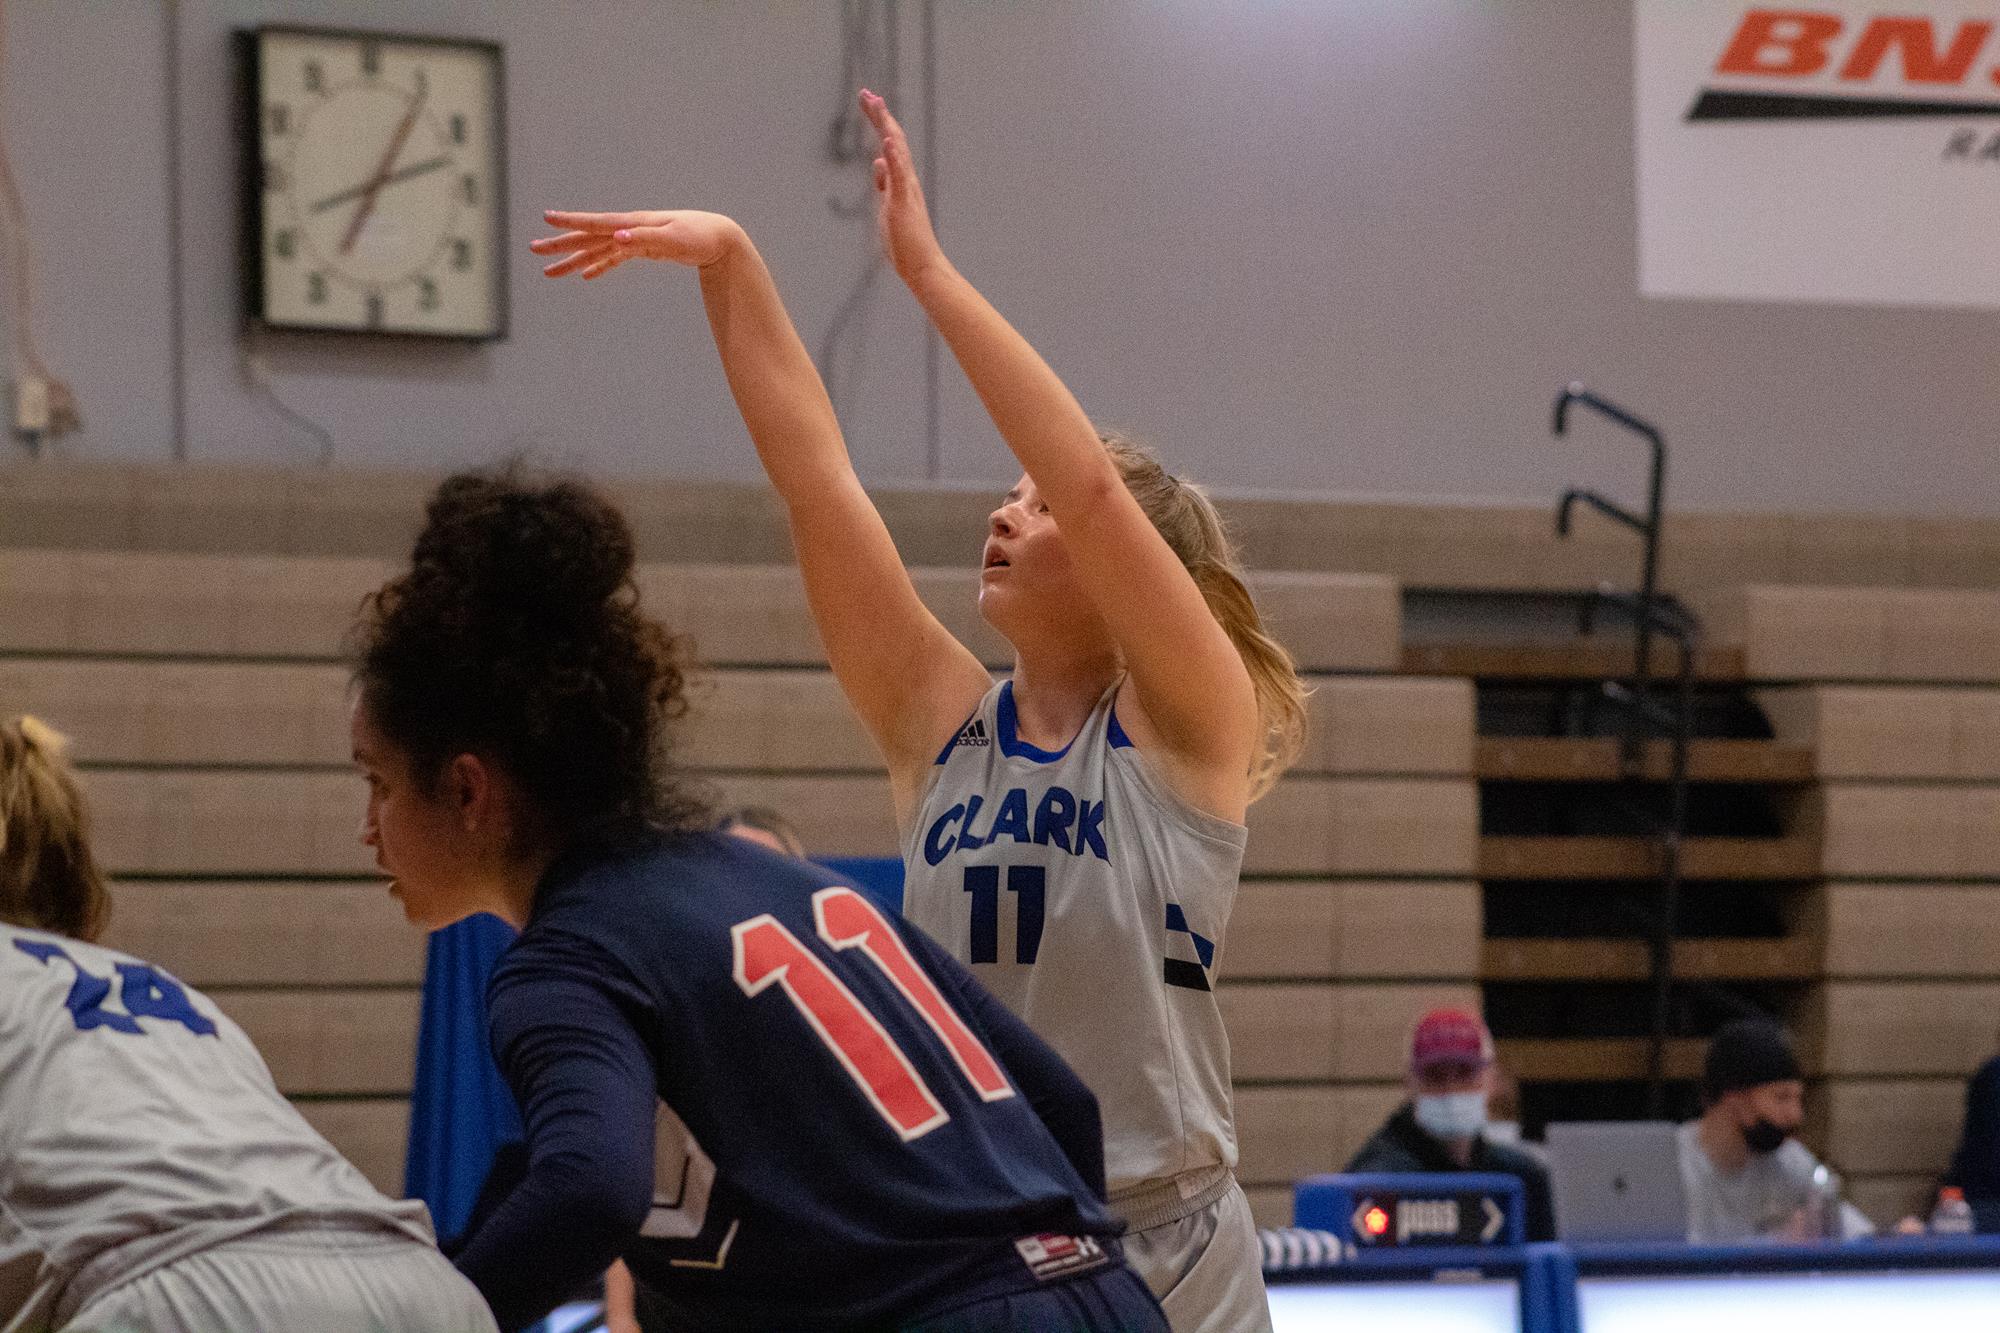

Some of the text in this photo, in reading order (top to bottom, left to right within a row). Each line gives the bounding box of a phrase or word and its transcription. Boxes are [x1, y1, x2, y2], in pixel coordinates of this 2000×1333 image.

[1714, 10, 2000, 88] BN
[923, 786, 1112, 867] CLARK
[963, 865, 1046, 965] 11
[731, 886, 1016, 1143] 11
